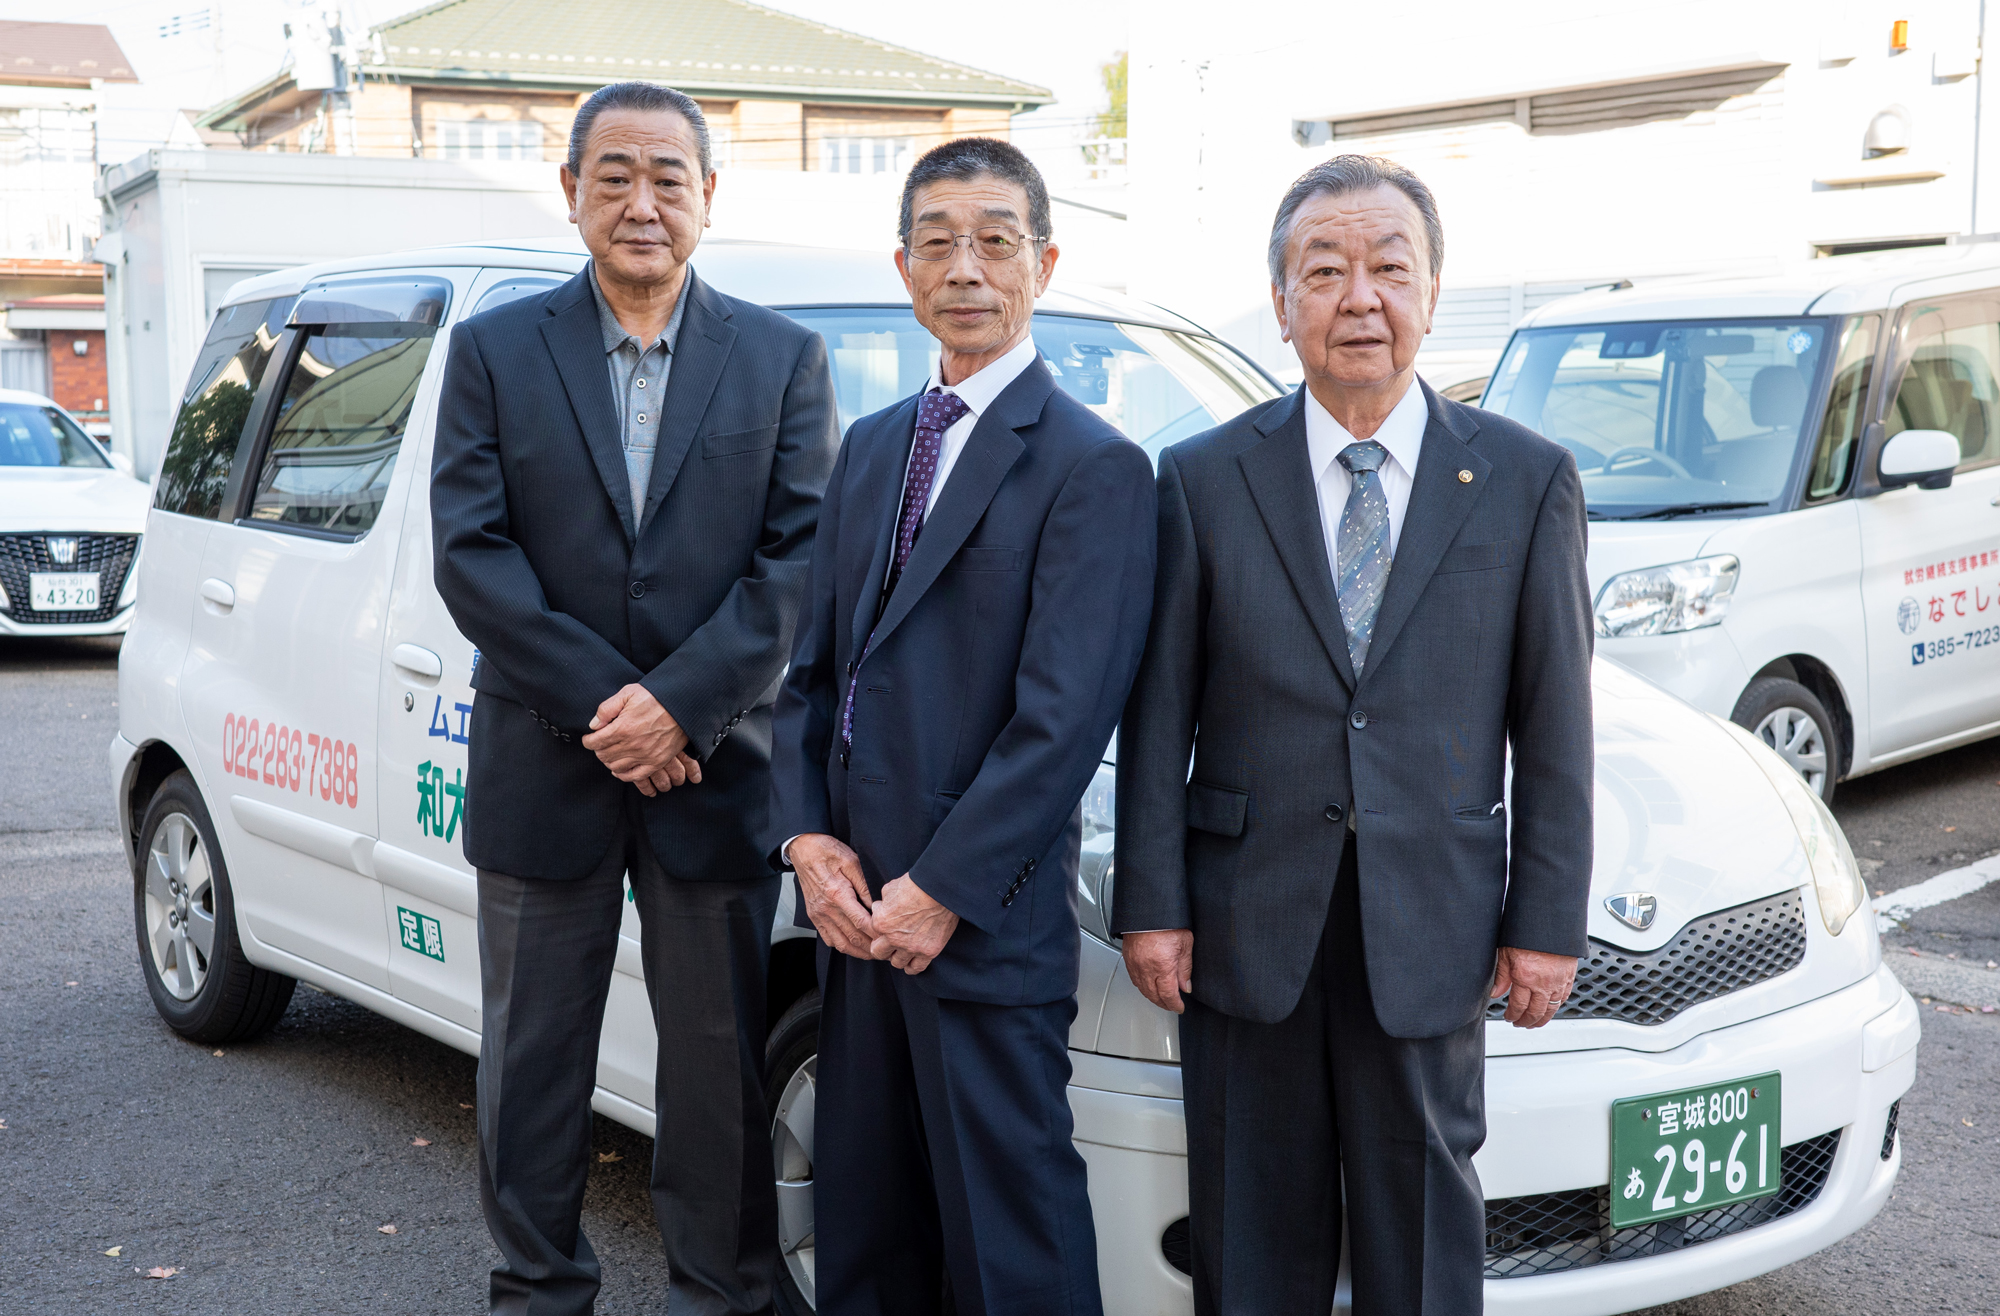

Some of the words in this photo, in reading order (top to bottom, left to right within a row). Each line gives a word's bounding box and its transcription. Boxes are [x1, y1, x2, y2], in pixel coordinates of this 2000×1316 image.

[46, 588, 96, 605] 43-20
[1928, 625, 2000, 660] 385-7223
[401, 911, 442, 958] 定限
[1623, 1167, 1645, 1200] あ
[1652, 1124, 1768, 1212] 29-61
